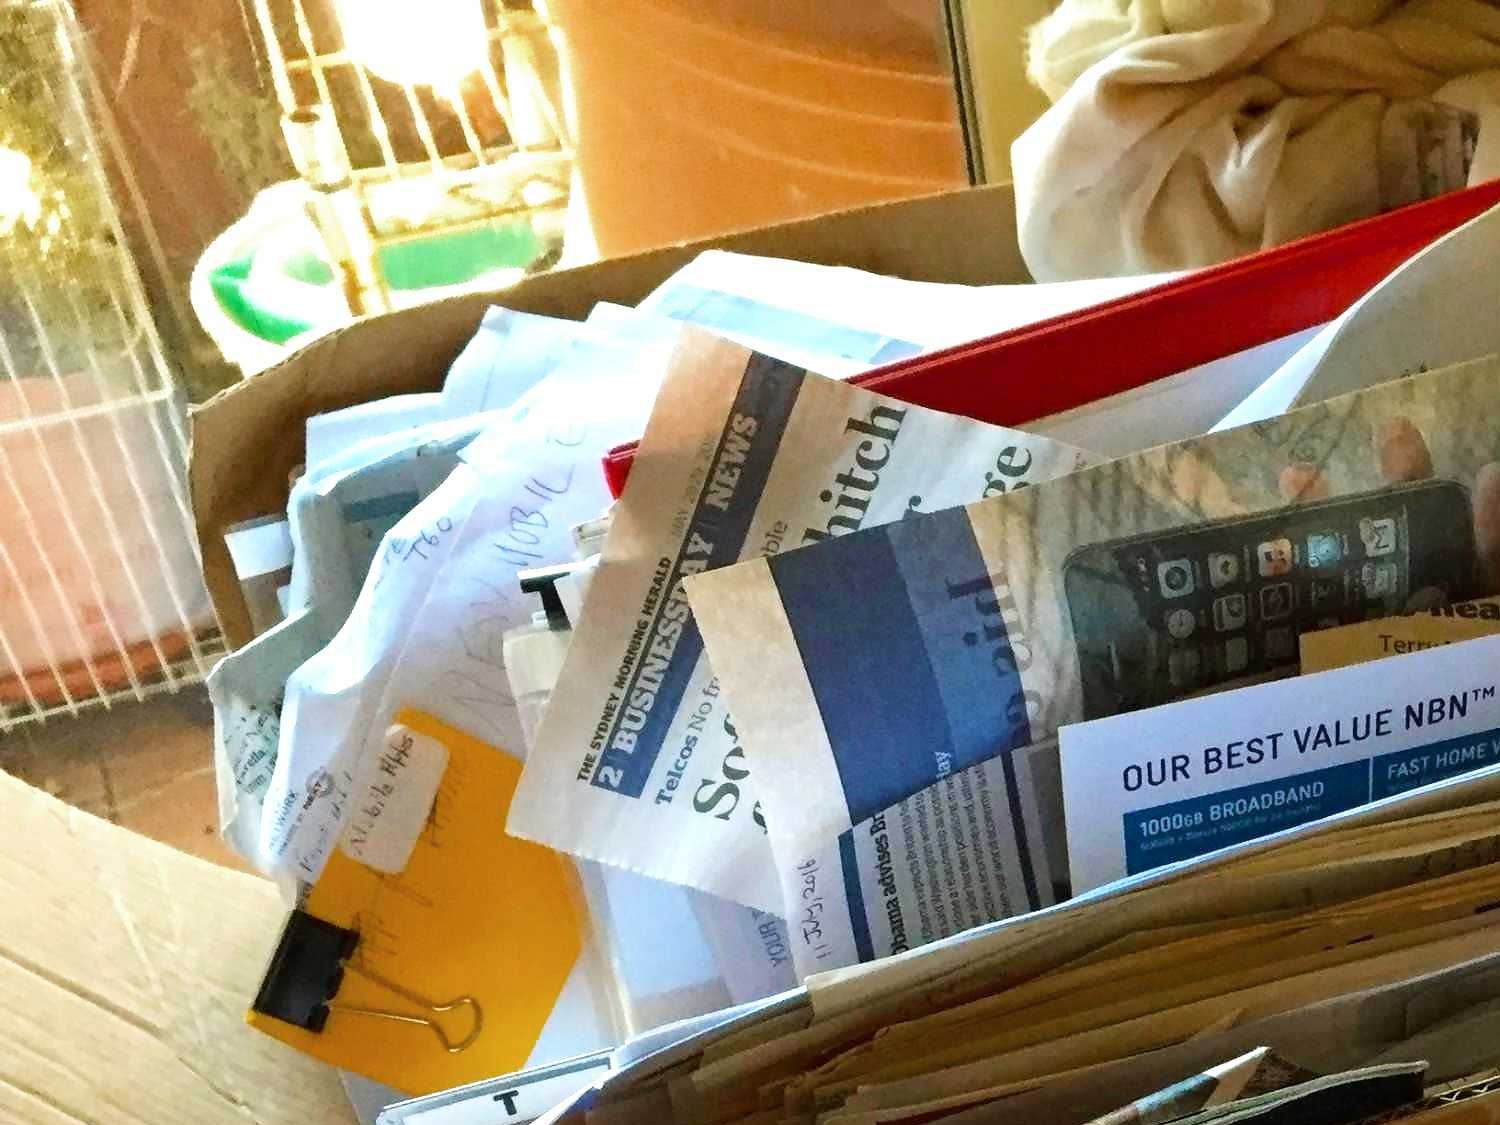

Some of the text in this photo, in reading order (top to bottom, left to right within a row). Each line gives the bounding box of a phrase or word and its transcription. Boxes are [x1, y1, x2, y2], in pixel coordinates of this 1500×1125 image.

[600, 765, 625, 788] 2
[704, 412, 760, 512] NEWS
[576, 752, 596, 782] THE
[590, 692, 622, 751] SYDNEY
[614, 620, 648, 690] MORNING
[638, 556, 672, 617] HERALD
[655, 734, 699, 806] Telcos
[689, 702, 715, 733] No
[1122, 754, 1190, 792] OUR
[1204, 733, 1284, 775] BEST
[1294, 709, 1393, 753] VALUE
[1387, 755, 1430, 781] FAST
[1435, 741, 1486, 770] HOME
[1139, 812, 1204, 838] 1000GB
[1210, 781, 1325, 821] BROADBAND
[875, 833, 898, 897] advises
[759, 919, 788, 968] YOUR
[494, 1089, 520, 1117] T
